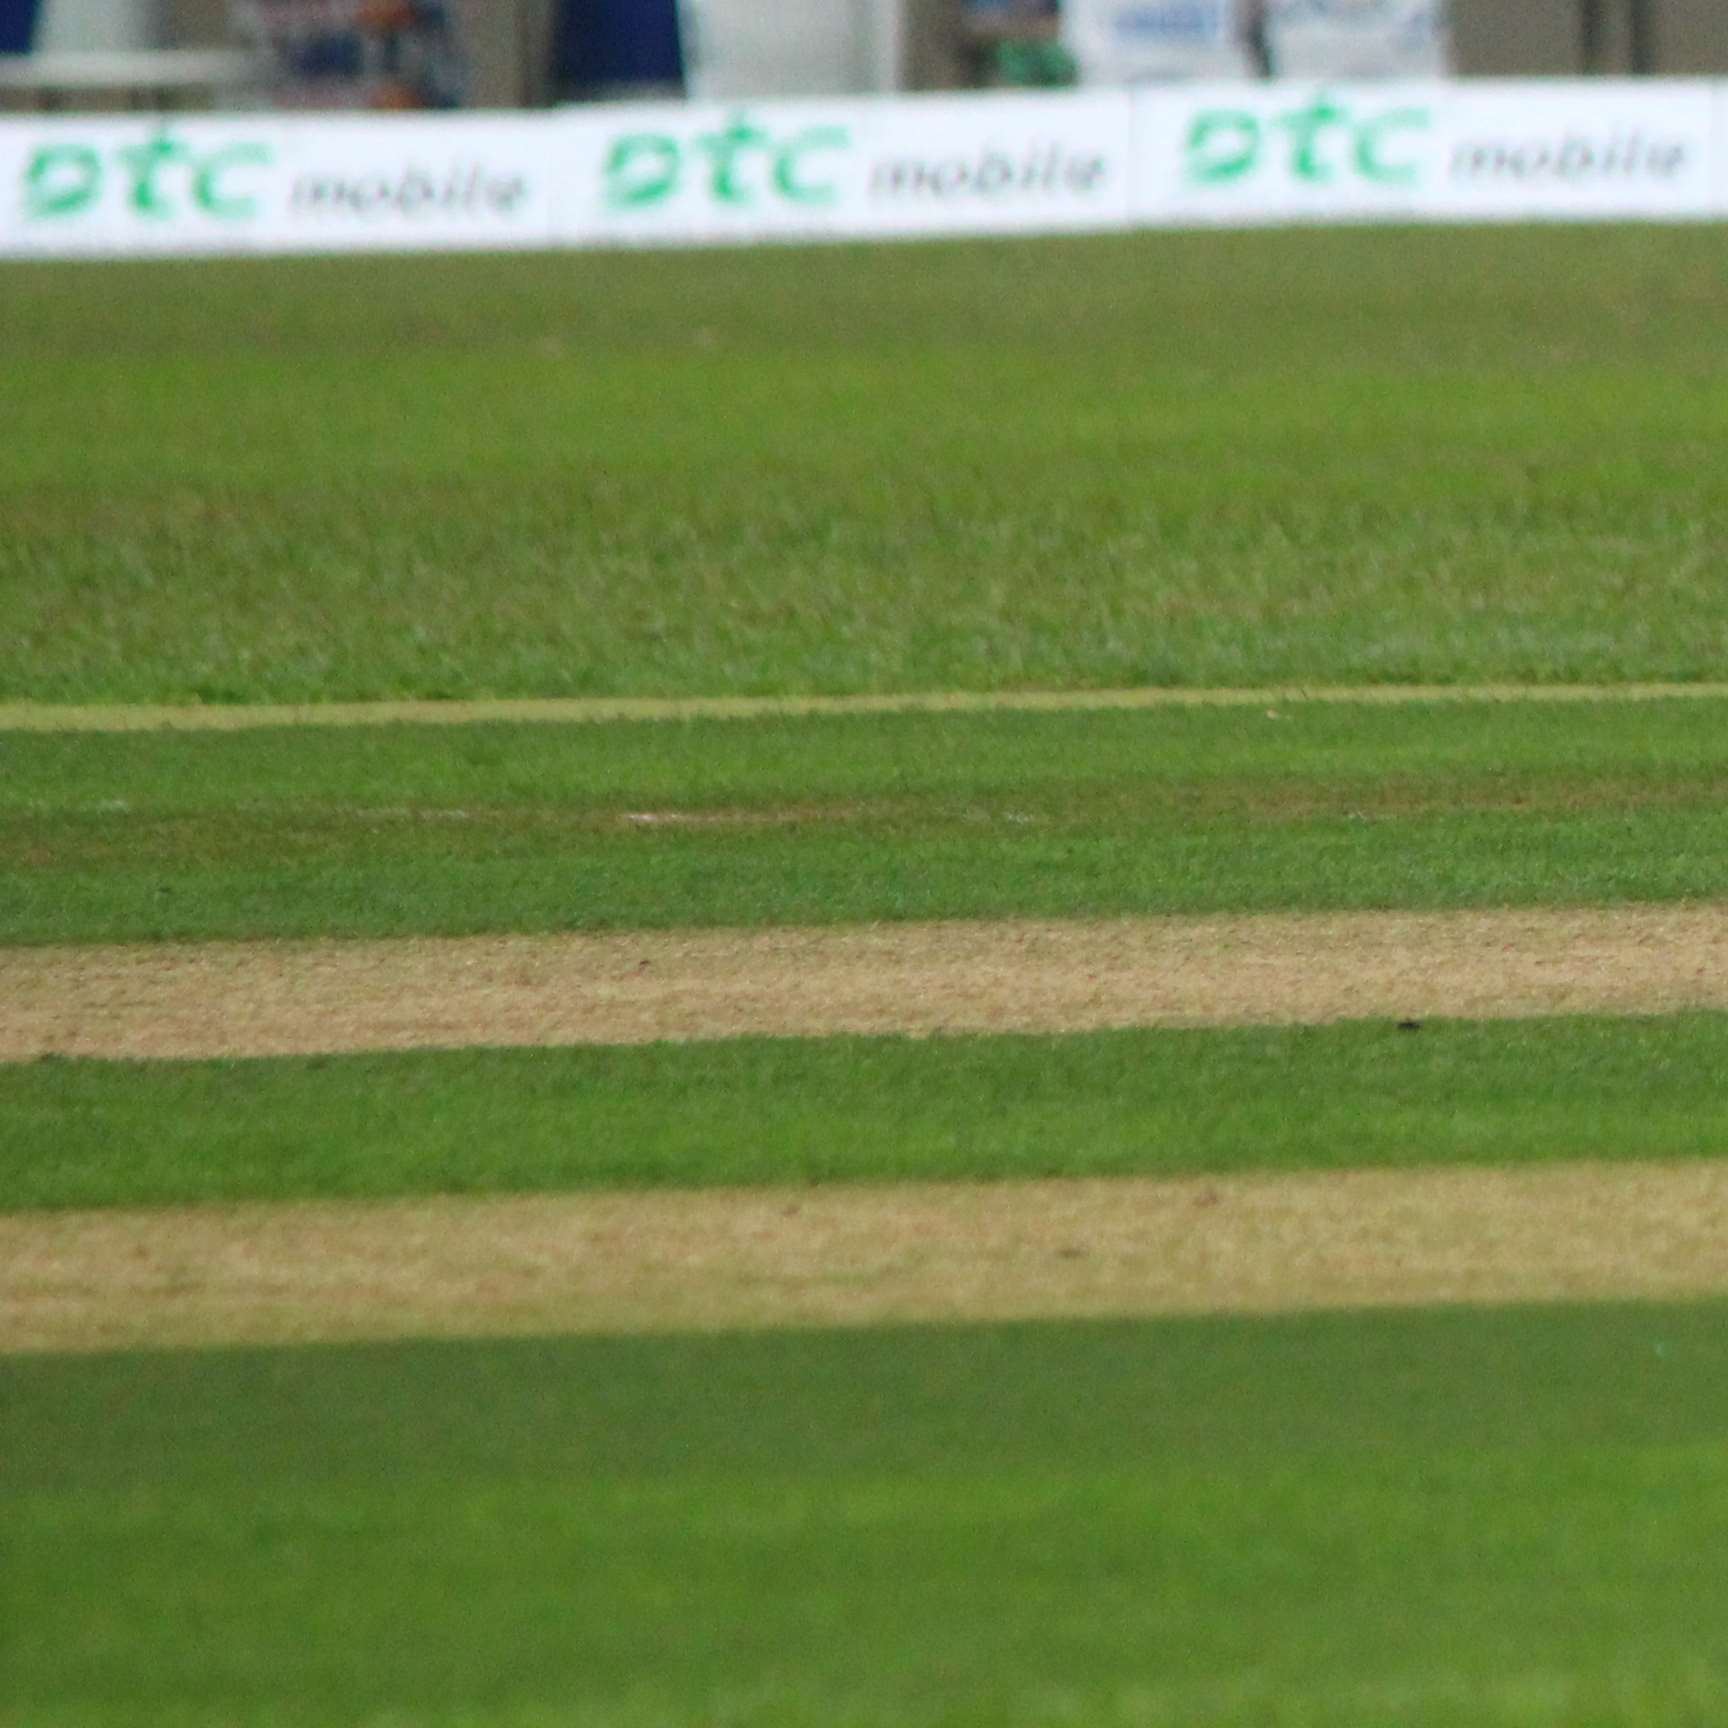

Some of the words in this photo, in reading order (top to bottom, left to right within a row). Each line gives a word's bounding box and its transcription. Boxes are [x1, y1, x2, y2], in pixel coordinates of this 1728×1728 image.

[866, 140, 1106, 204] mobile
[1450, 122, 1688, 184] mobile
[288, 156, 528, 224] mobile
